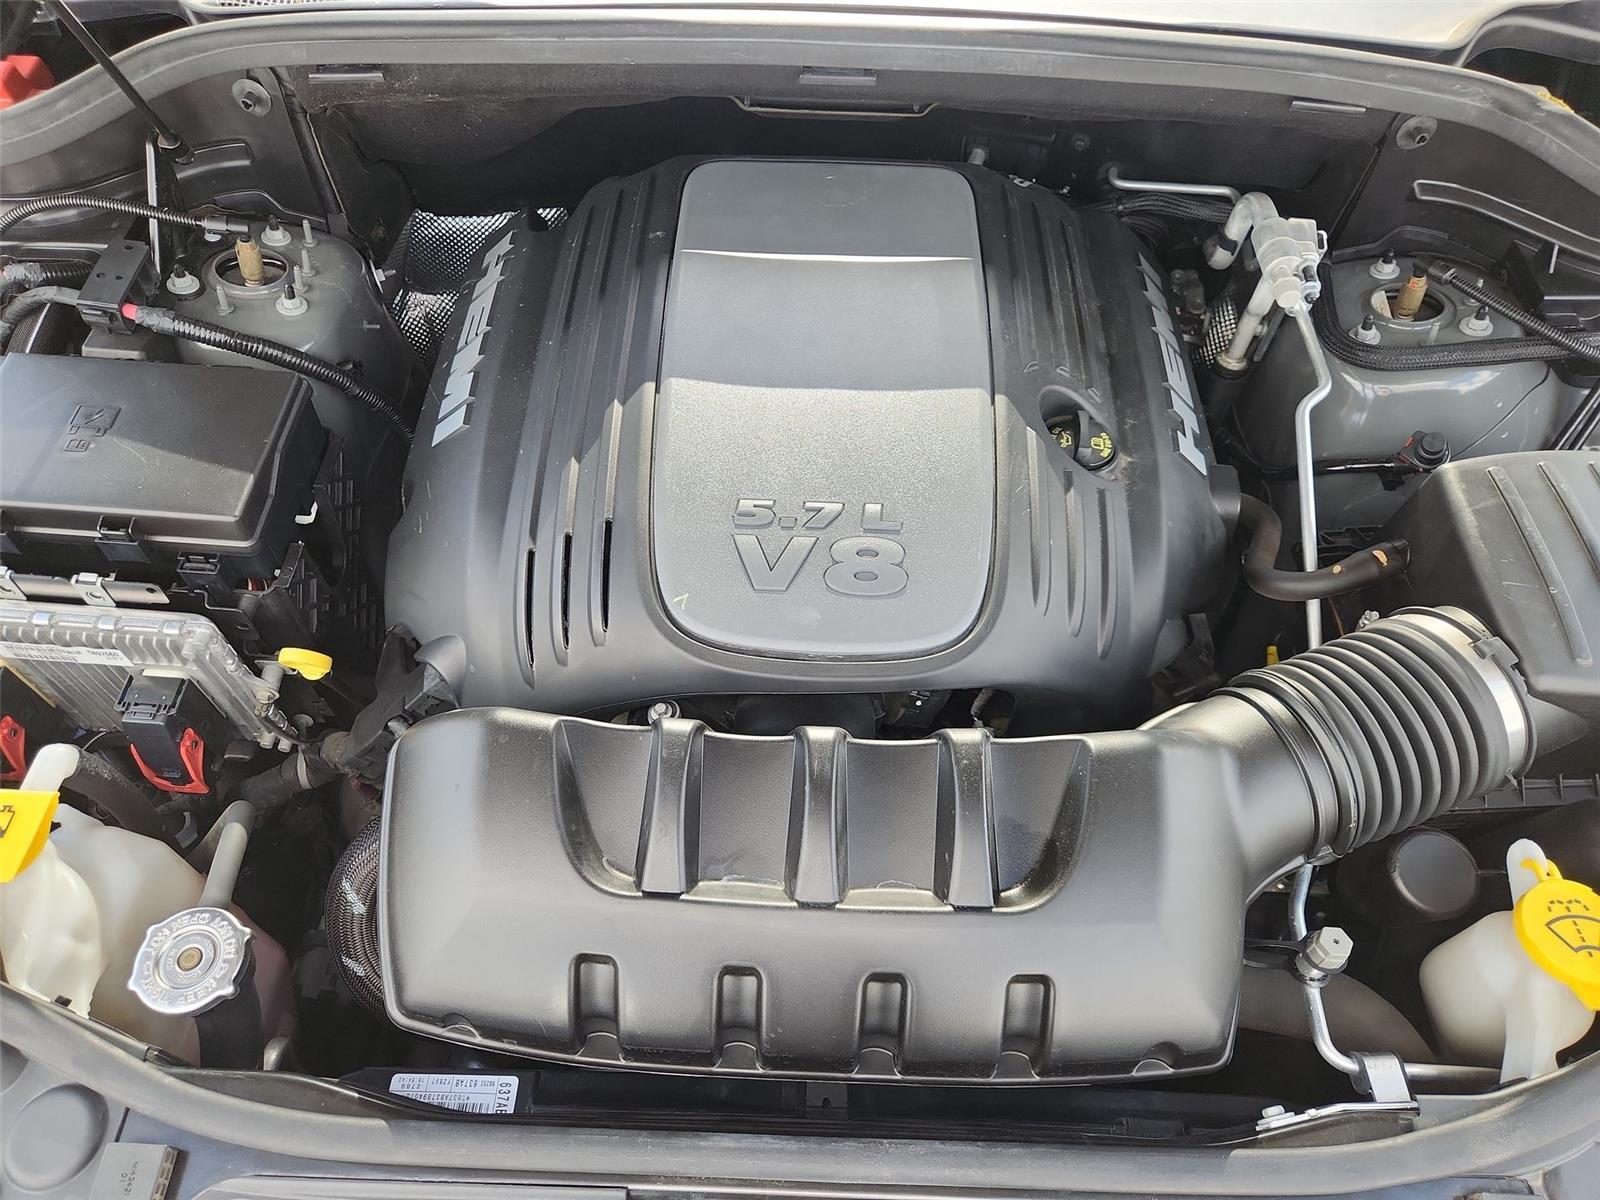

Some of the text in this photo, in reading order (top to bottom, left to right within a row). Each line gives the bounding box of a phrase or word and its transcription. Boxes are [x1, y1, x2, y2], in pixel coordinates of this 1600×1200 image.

[432, 231, 514, 447] HEMI
[1137, 254, 1209, 478] HEMI
[732, 498, 903, 534] 5.7 L
[732, 534, 909, 597] V8
[171, 912, 211, 931] OPEN
